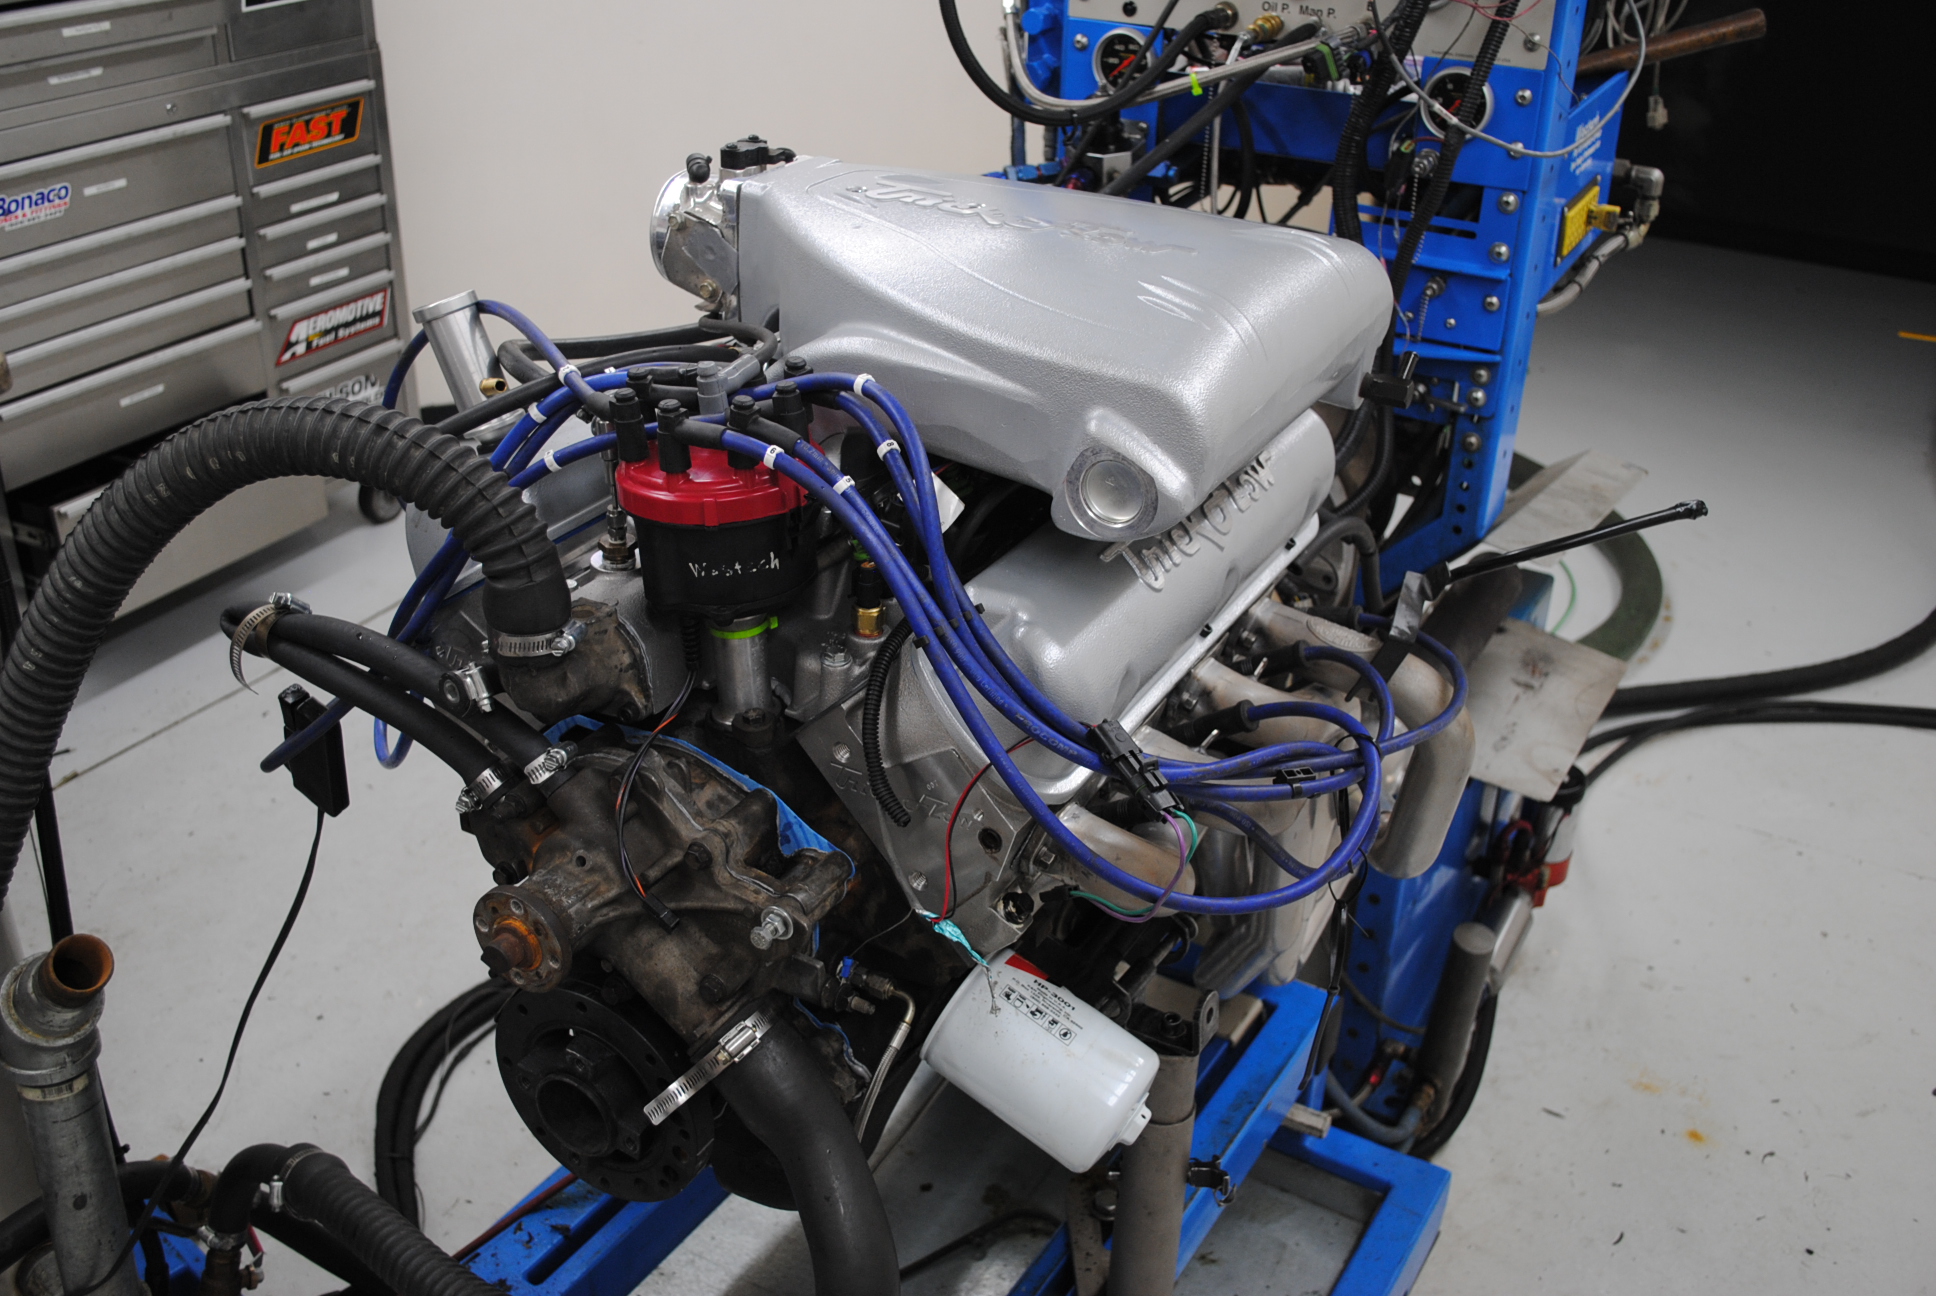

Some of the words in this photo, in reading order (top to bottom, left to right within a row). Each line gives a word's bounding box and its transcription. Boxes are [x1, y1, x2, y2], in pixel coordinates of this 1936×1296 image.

[1262, 1, 1277, 12] Oil
[270, 109, 348, 154] FAST
[312, 331, 336, 348] Fuel
[338, 316, 381, 337] Systems
[1033, 979, 1076, 1011] HP-3001
